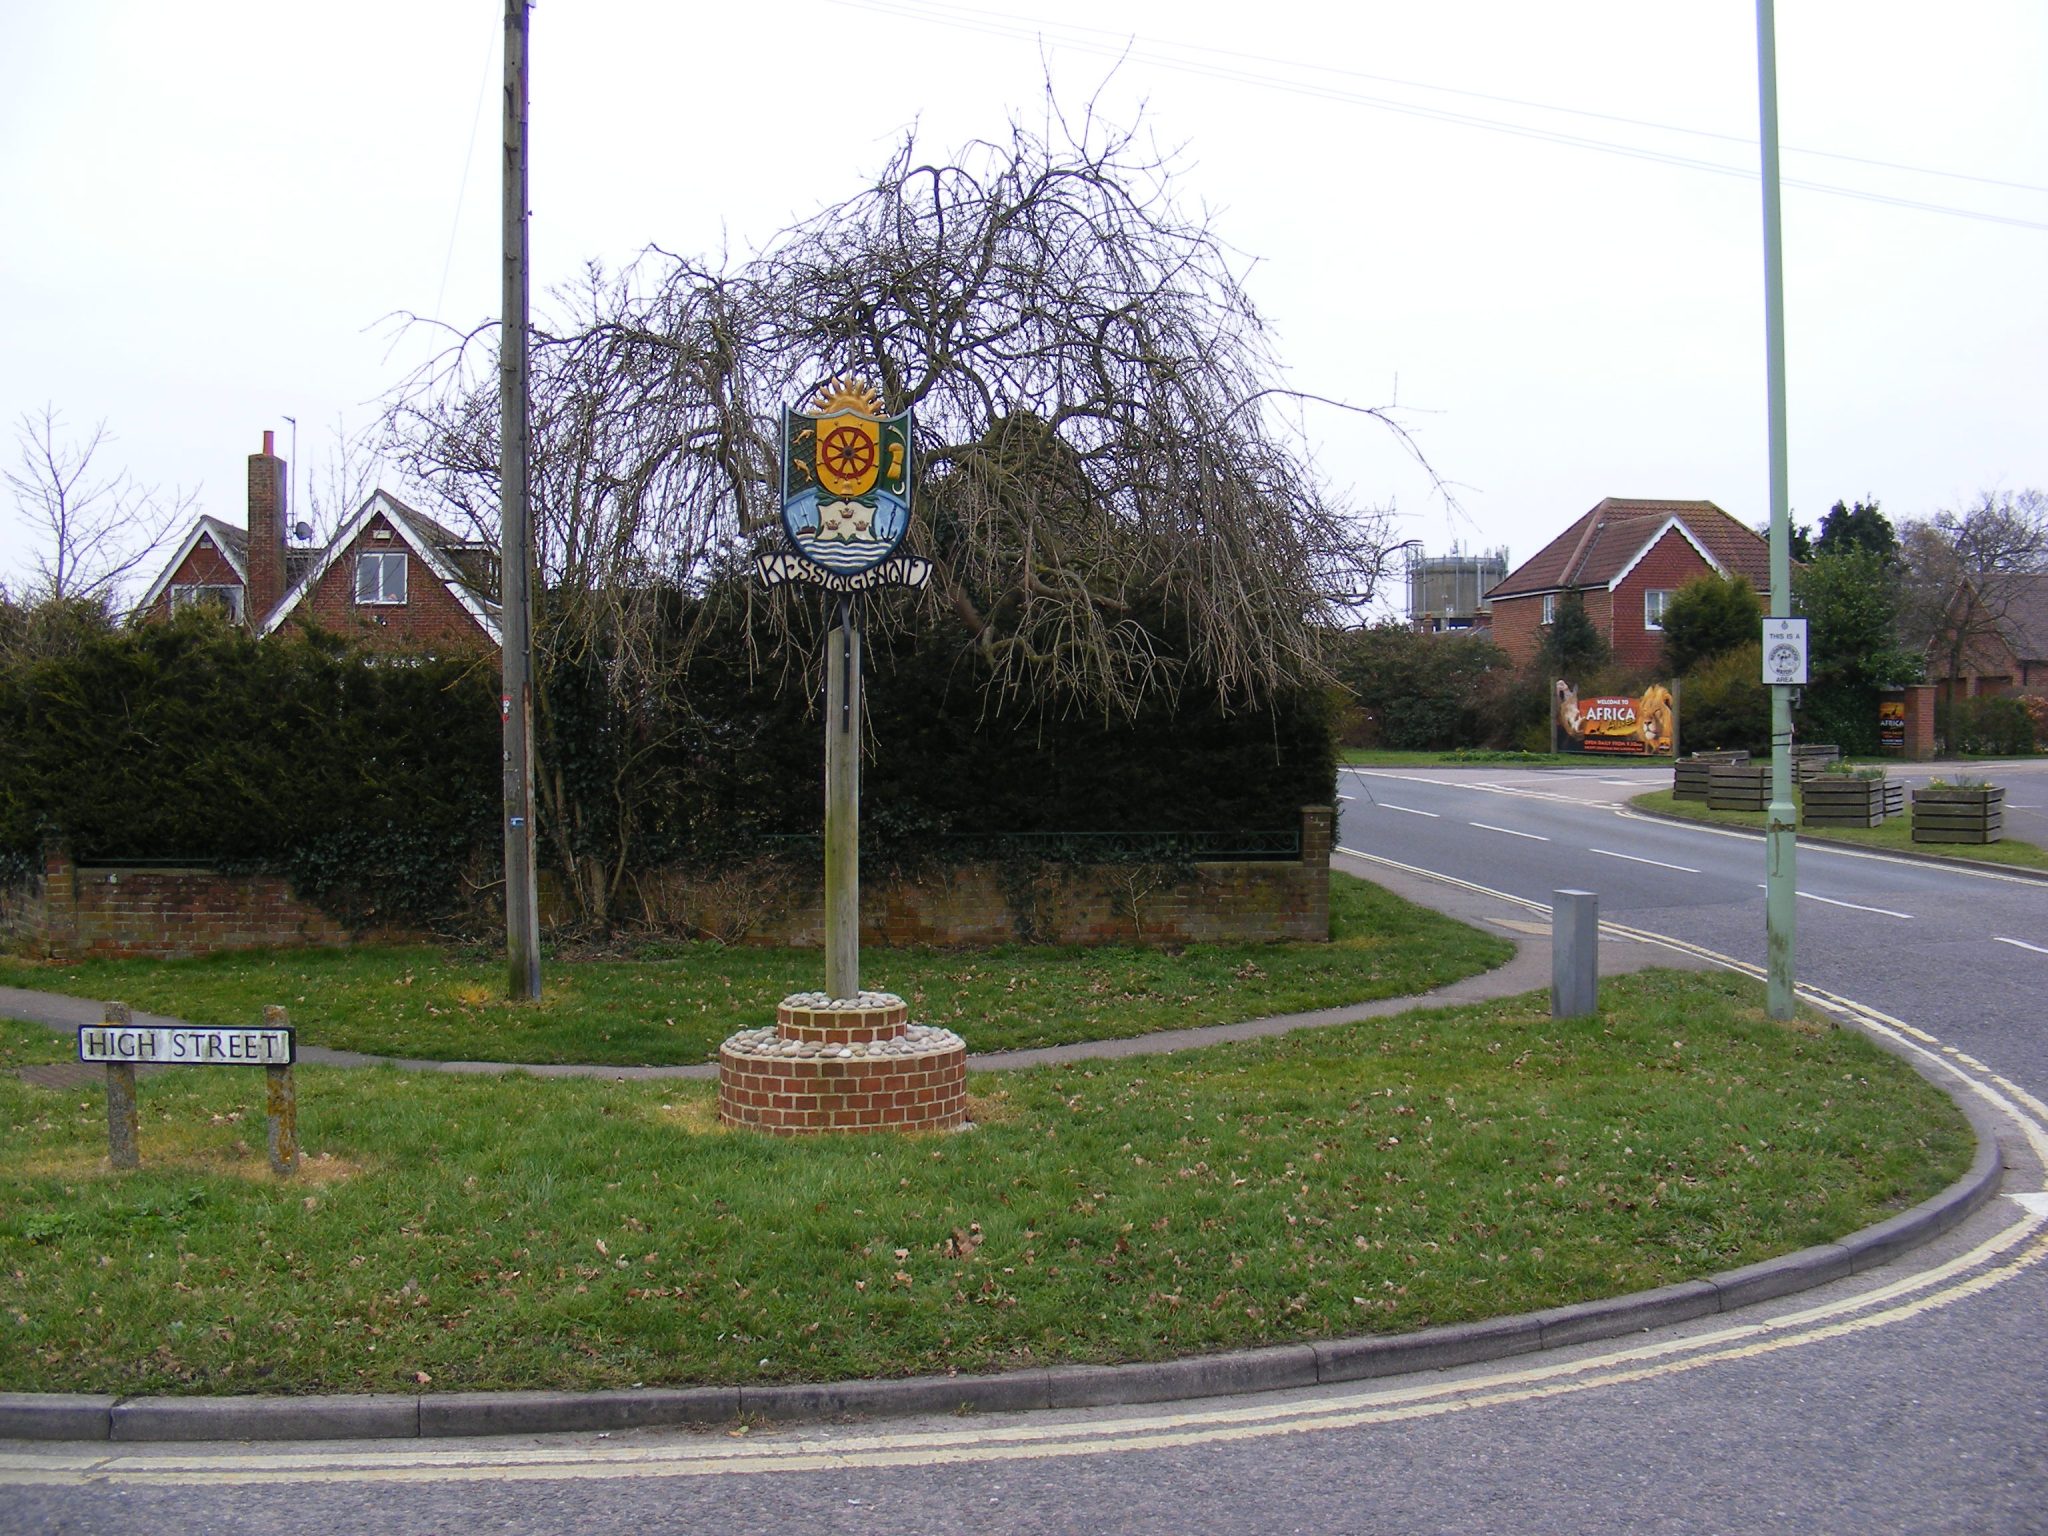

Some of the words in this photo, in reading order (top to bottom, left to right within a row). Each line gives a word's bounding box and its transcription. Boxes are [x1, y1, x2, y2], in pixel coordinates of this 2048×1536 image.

[757, 554, 933, 593] KESSINGLAND
[1586, 707, 1636, 720] AFRICA
[1880, 719, 1904, 727] AFRICA
[89, 1033, 156, 1056] HIGH
[173, 1033, 278, 1059] STREET
